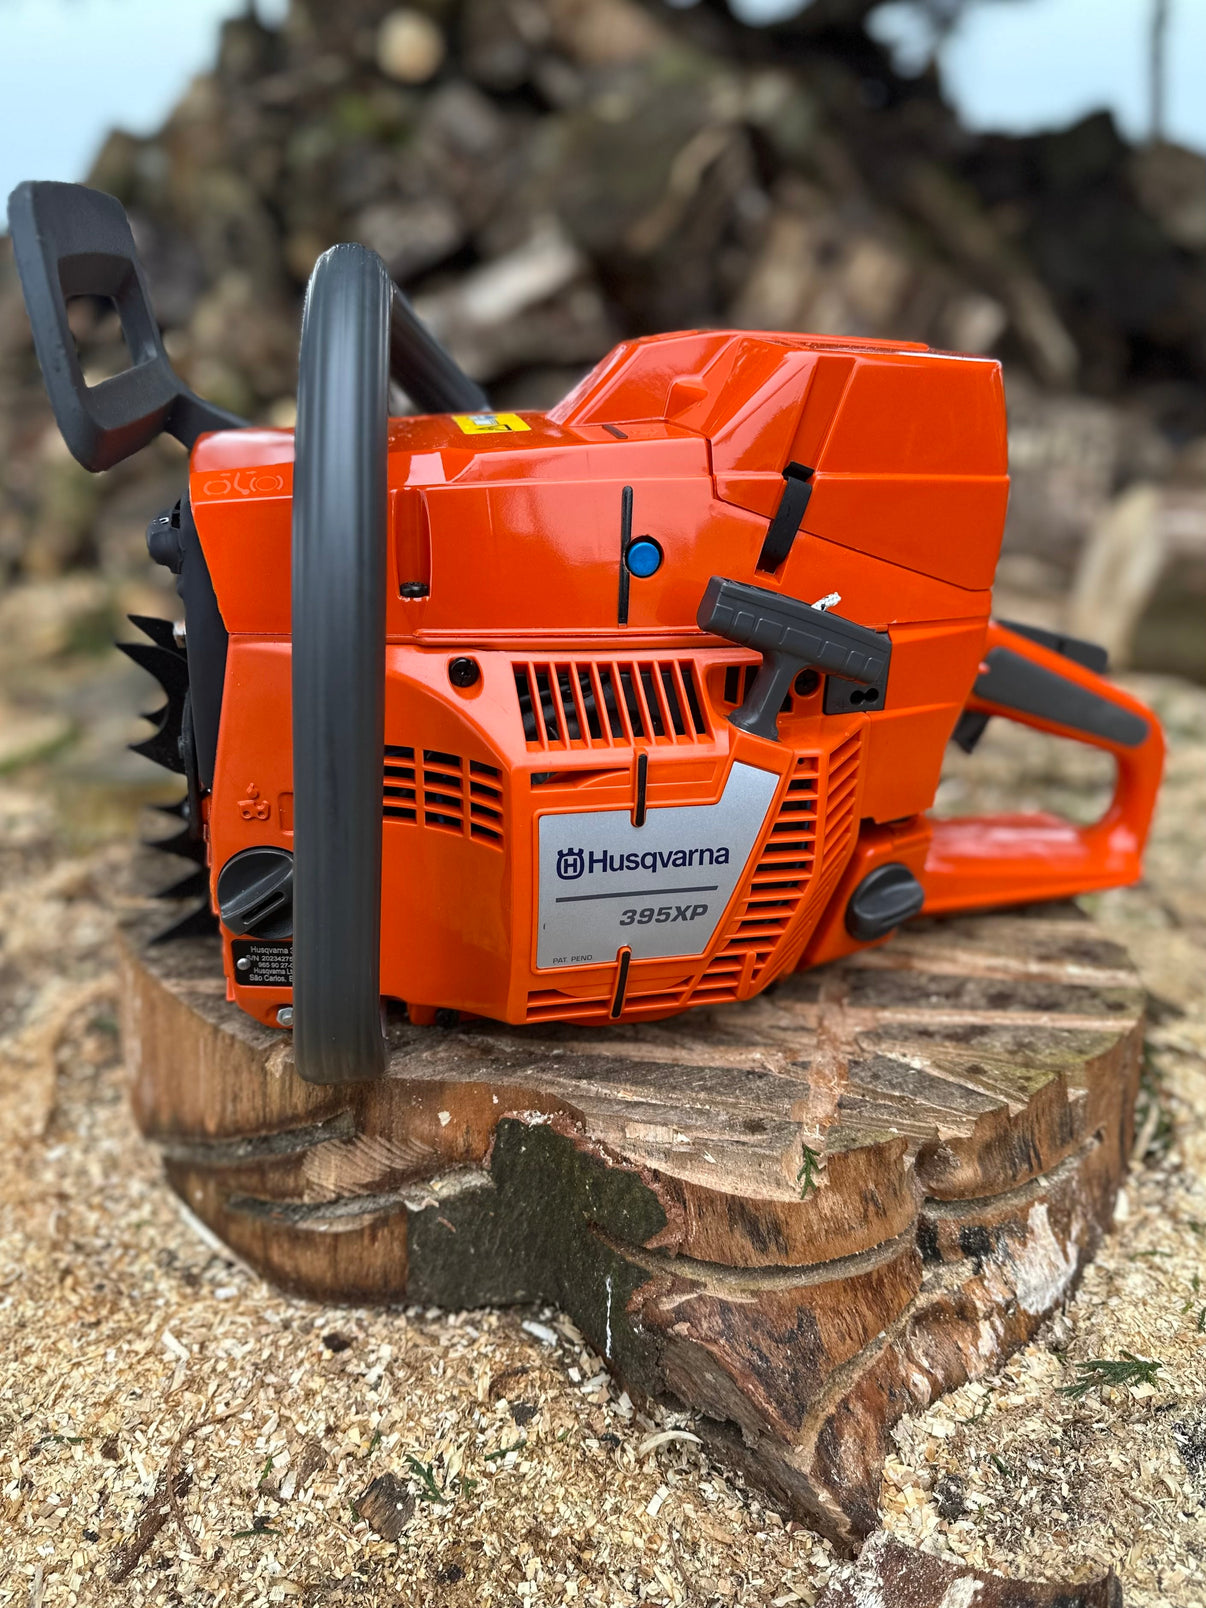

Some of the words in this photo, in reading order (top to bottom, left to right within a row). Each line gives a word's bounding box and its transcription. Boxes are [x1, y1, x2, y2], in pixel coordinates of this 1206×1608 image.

[588, 846, 730, 874] Husqvarna
[619, 904, 708, 926] 395XP
[250, 946, 288, 954] Husqvarna
[571, 954, 593, 962] PEND
[253, 967, 286, 975] Husqvarna
